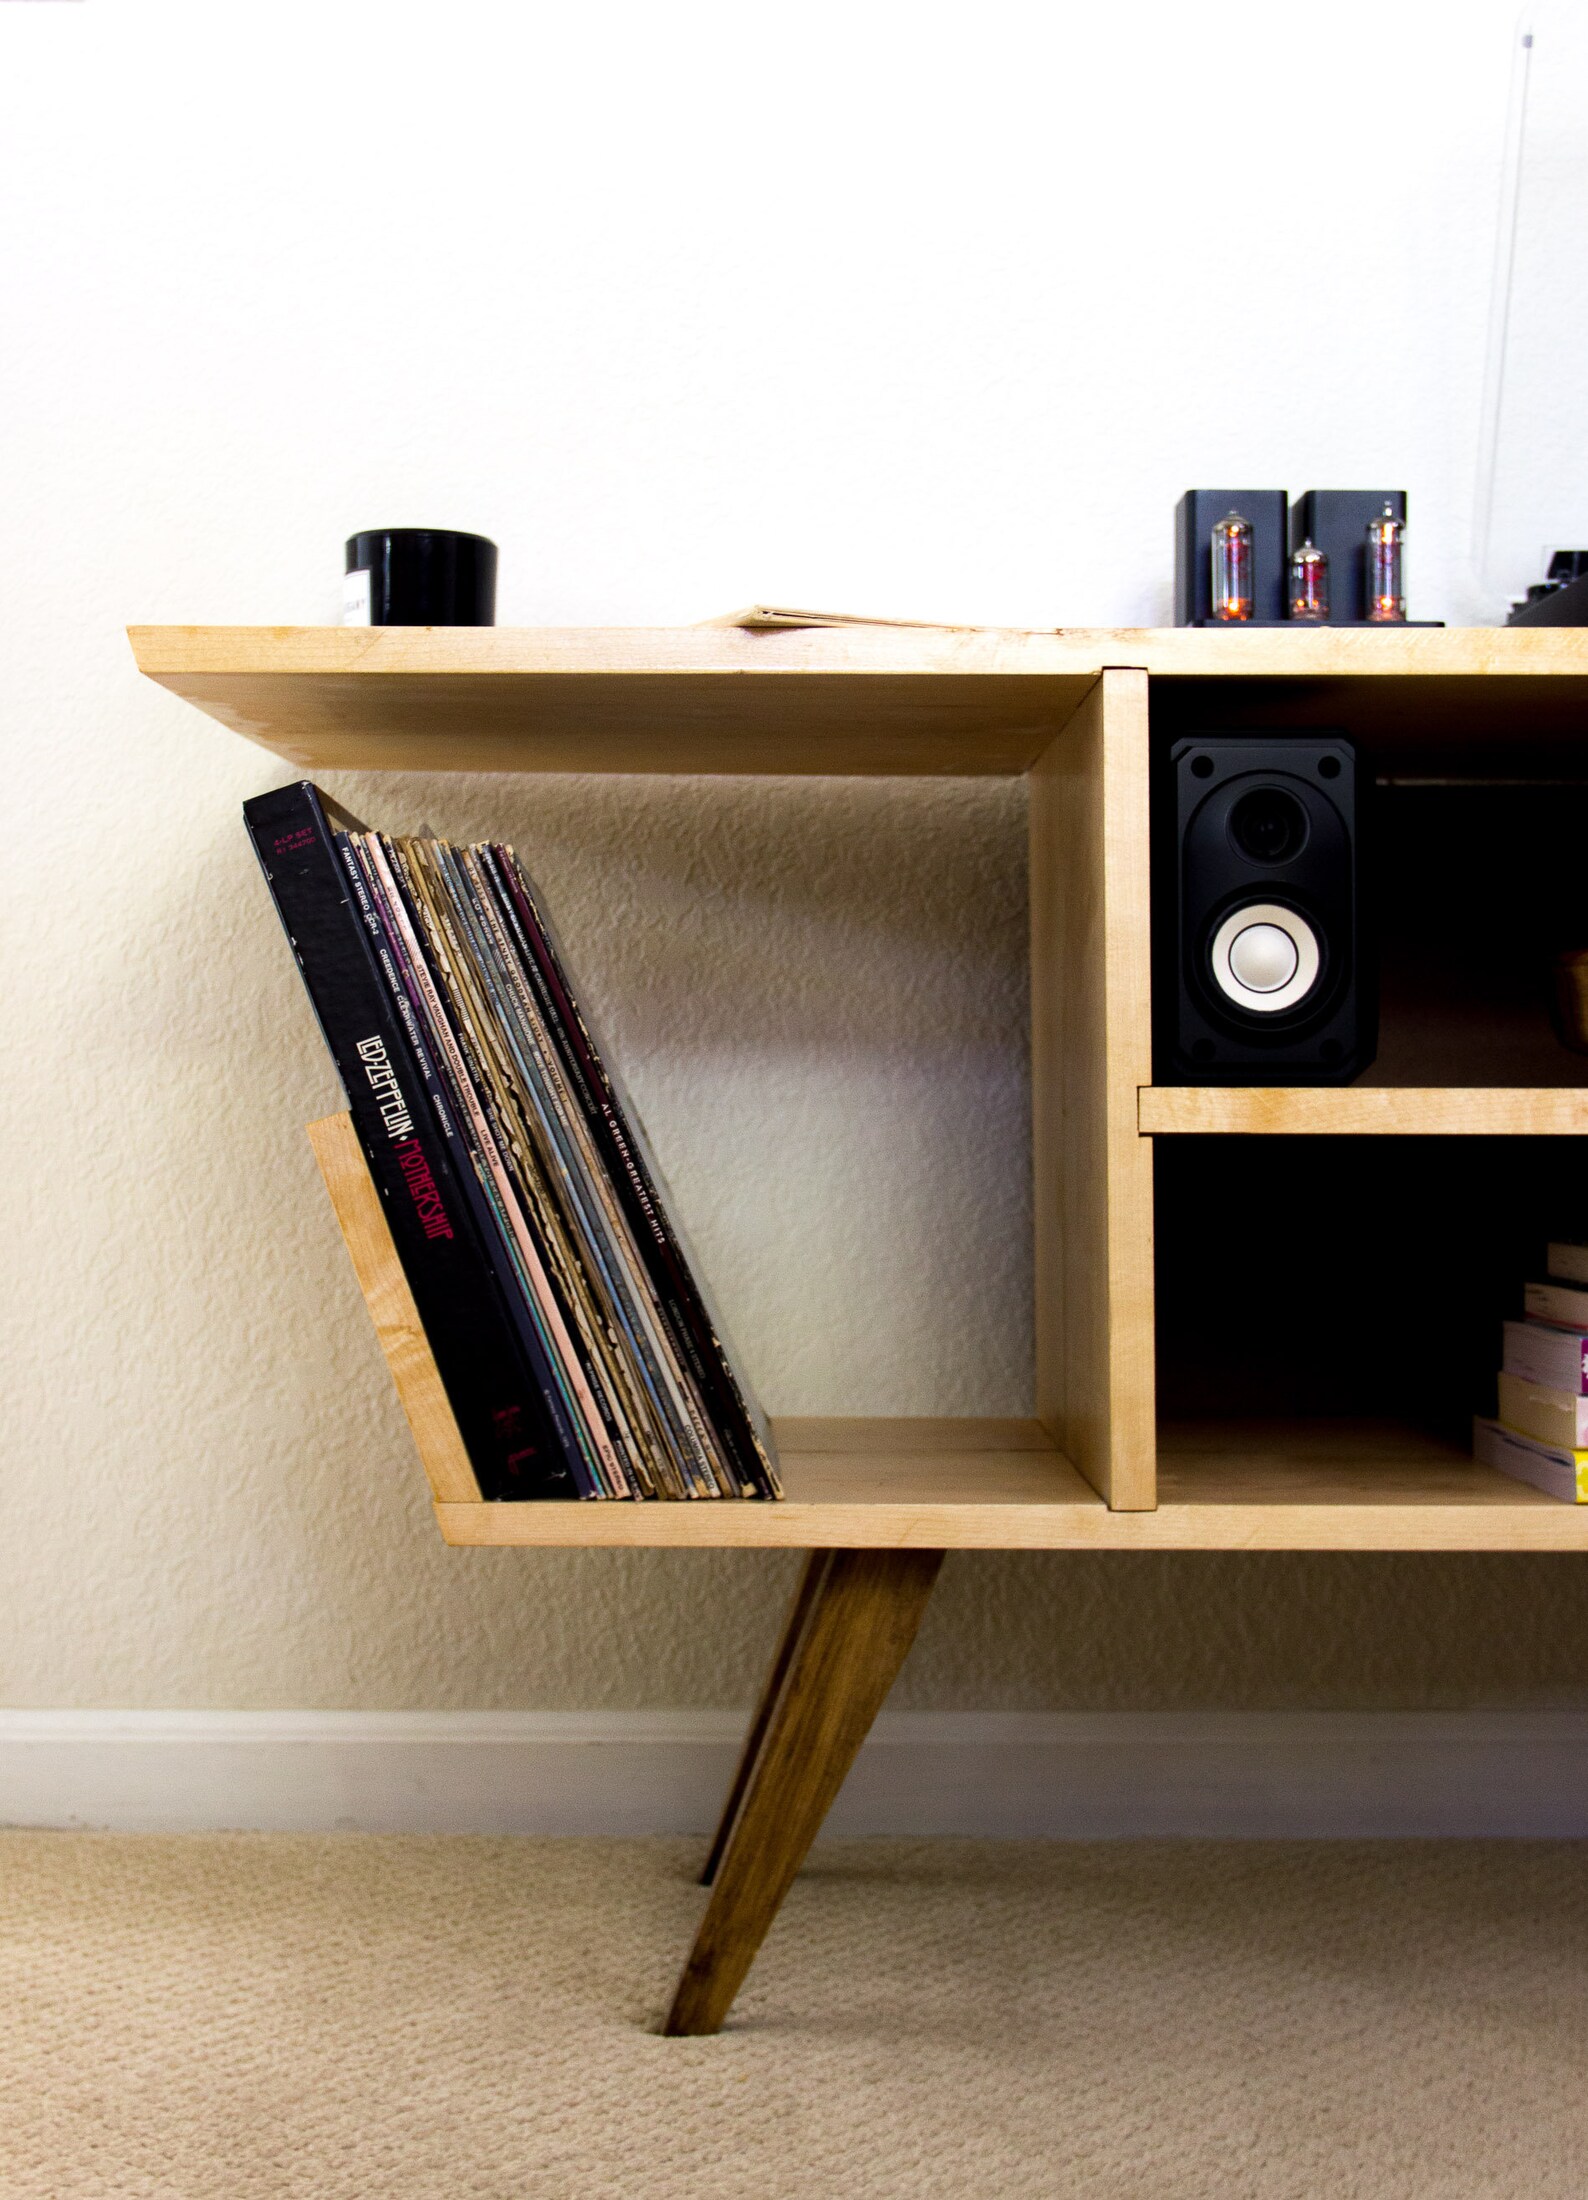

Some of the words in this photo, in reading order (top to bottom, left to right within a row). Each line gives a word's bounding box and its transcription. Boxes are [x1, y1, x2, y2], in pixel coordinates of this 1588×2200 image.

[339, 846, 360, 881] FANTASY
[353, 880, 371, 911] STEREO
[415, 963, 431, 989] STEVIE
[508, 967, 532, 1014] GOODMAN
[378, 947, 401, 993] CREEDENCE
[394, 994, 421, 1046] CLEARWATER
[414, 1046, 433, 1080] REVIVAL
[425, 988, 436, 1004] RAY
[504, 982, 520, 1009] CHUCK
[514, 1006, 535, 1047] MANGIONE
[533, 972, 553, 1006] CARNEGIE
[547, 1004, 560, 1024] HALL
[430, 1003, 450, 1038] VAUGHAN
[444, 1037, 456, 1055] AND
[455, 1031, 470, 1056] FRANK
[464, 1054, 481, 1084] SINATRA
[450, 1053, 467, 1084] DOUBLE
[539, 1068, 558, 1102] TONIGHT
[545, 1060, 564, 1095] VOLUME
[561, 1038, 585, 1084] ANNIVERSARY
[578, 1082, 598, 1116] CONCERT
[431, 1093, 454, 1138] CHRONICLE
[461, 1082, 480, 1118] TROUBLE
[484, 1107, 496, 1122] SHE
[479, 1128, 491, 1146] LIVE
[485, 1145, 499, 1167] ALIVE
[490, 1121, 503, 1140] SHOT
[497, 1139, 507, 1151] ME
[500, 1150, 515, 1172] DOWN
[600, 1101, 612, 1117] AL
[649, 1218, 666, 1245] HITS
[392, 1136, 455, 1246] MOTHERSHIP
[468, 1126, 486, 1160] LUXURY
[482, 1163, 494, 1182] YOU
[489, 1183, 501, 1202] CAN
[497, 1204, 515, 1239] AFFORD
[667, 1297, 685, 1328] LONDON
[678, 1326, 694, 1350] PHASE
[583, 1361, 600, 1390] REPRISE
[594, 1389, 612, 1423] RECORDS
[600, 1443, 613, 1462] EPIC
[683, 1423, 703, 1461] COLUMBIA
